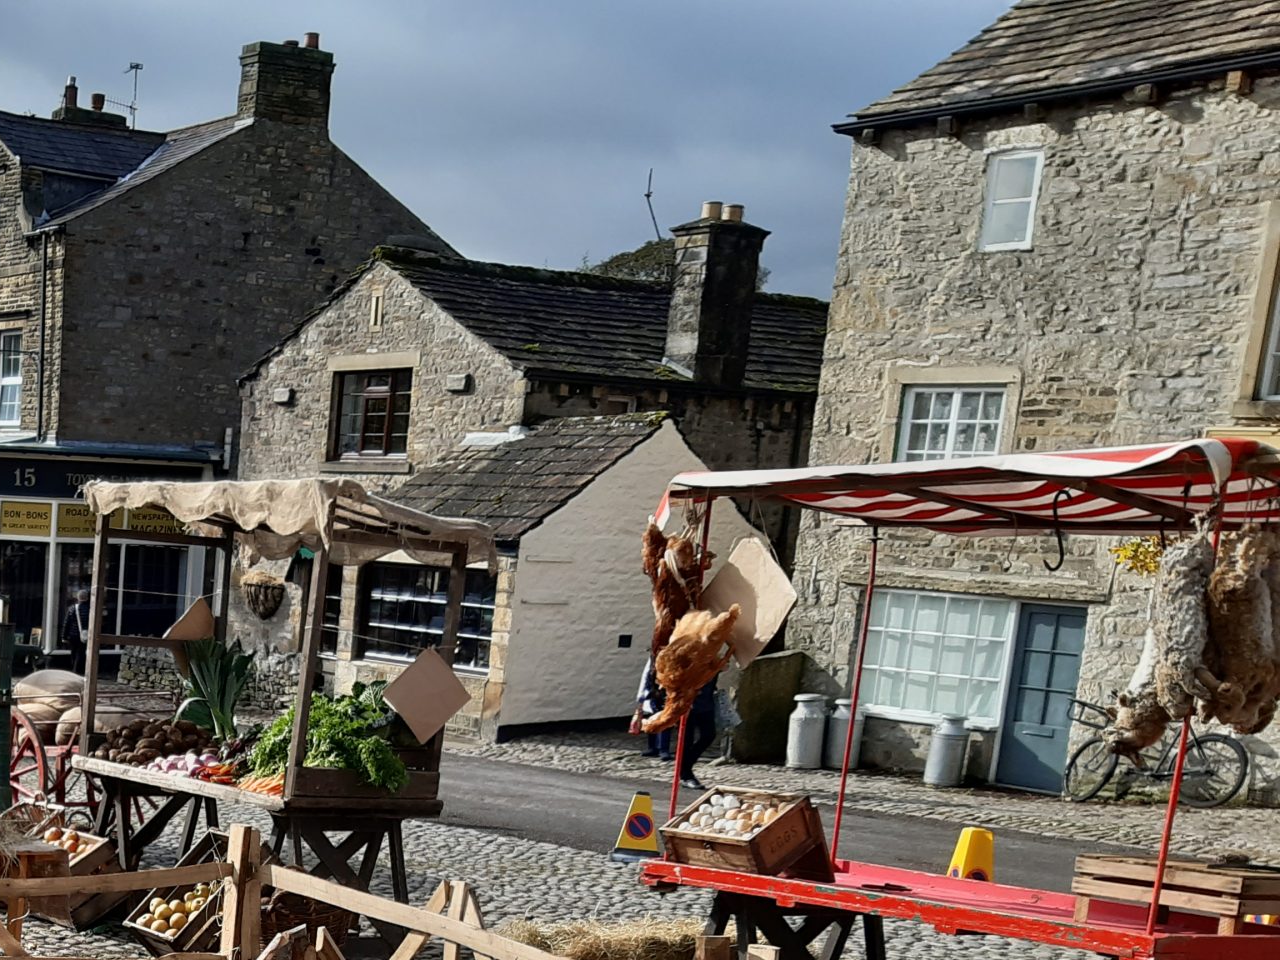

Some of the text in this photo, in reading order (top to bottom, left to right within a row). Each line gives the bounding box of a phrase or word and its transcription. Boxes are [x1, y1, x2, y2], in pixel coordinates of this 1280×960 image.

[13, 468, 36, 487] 15
[3, 510, 49, 520] BON-BONS
[65, 508, 89, 517] ROAD
[132, 513, 175, 521] NEWSPAPER
[770, 825, 800, 855] EGGS
